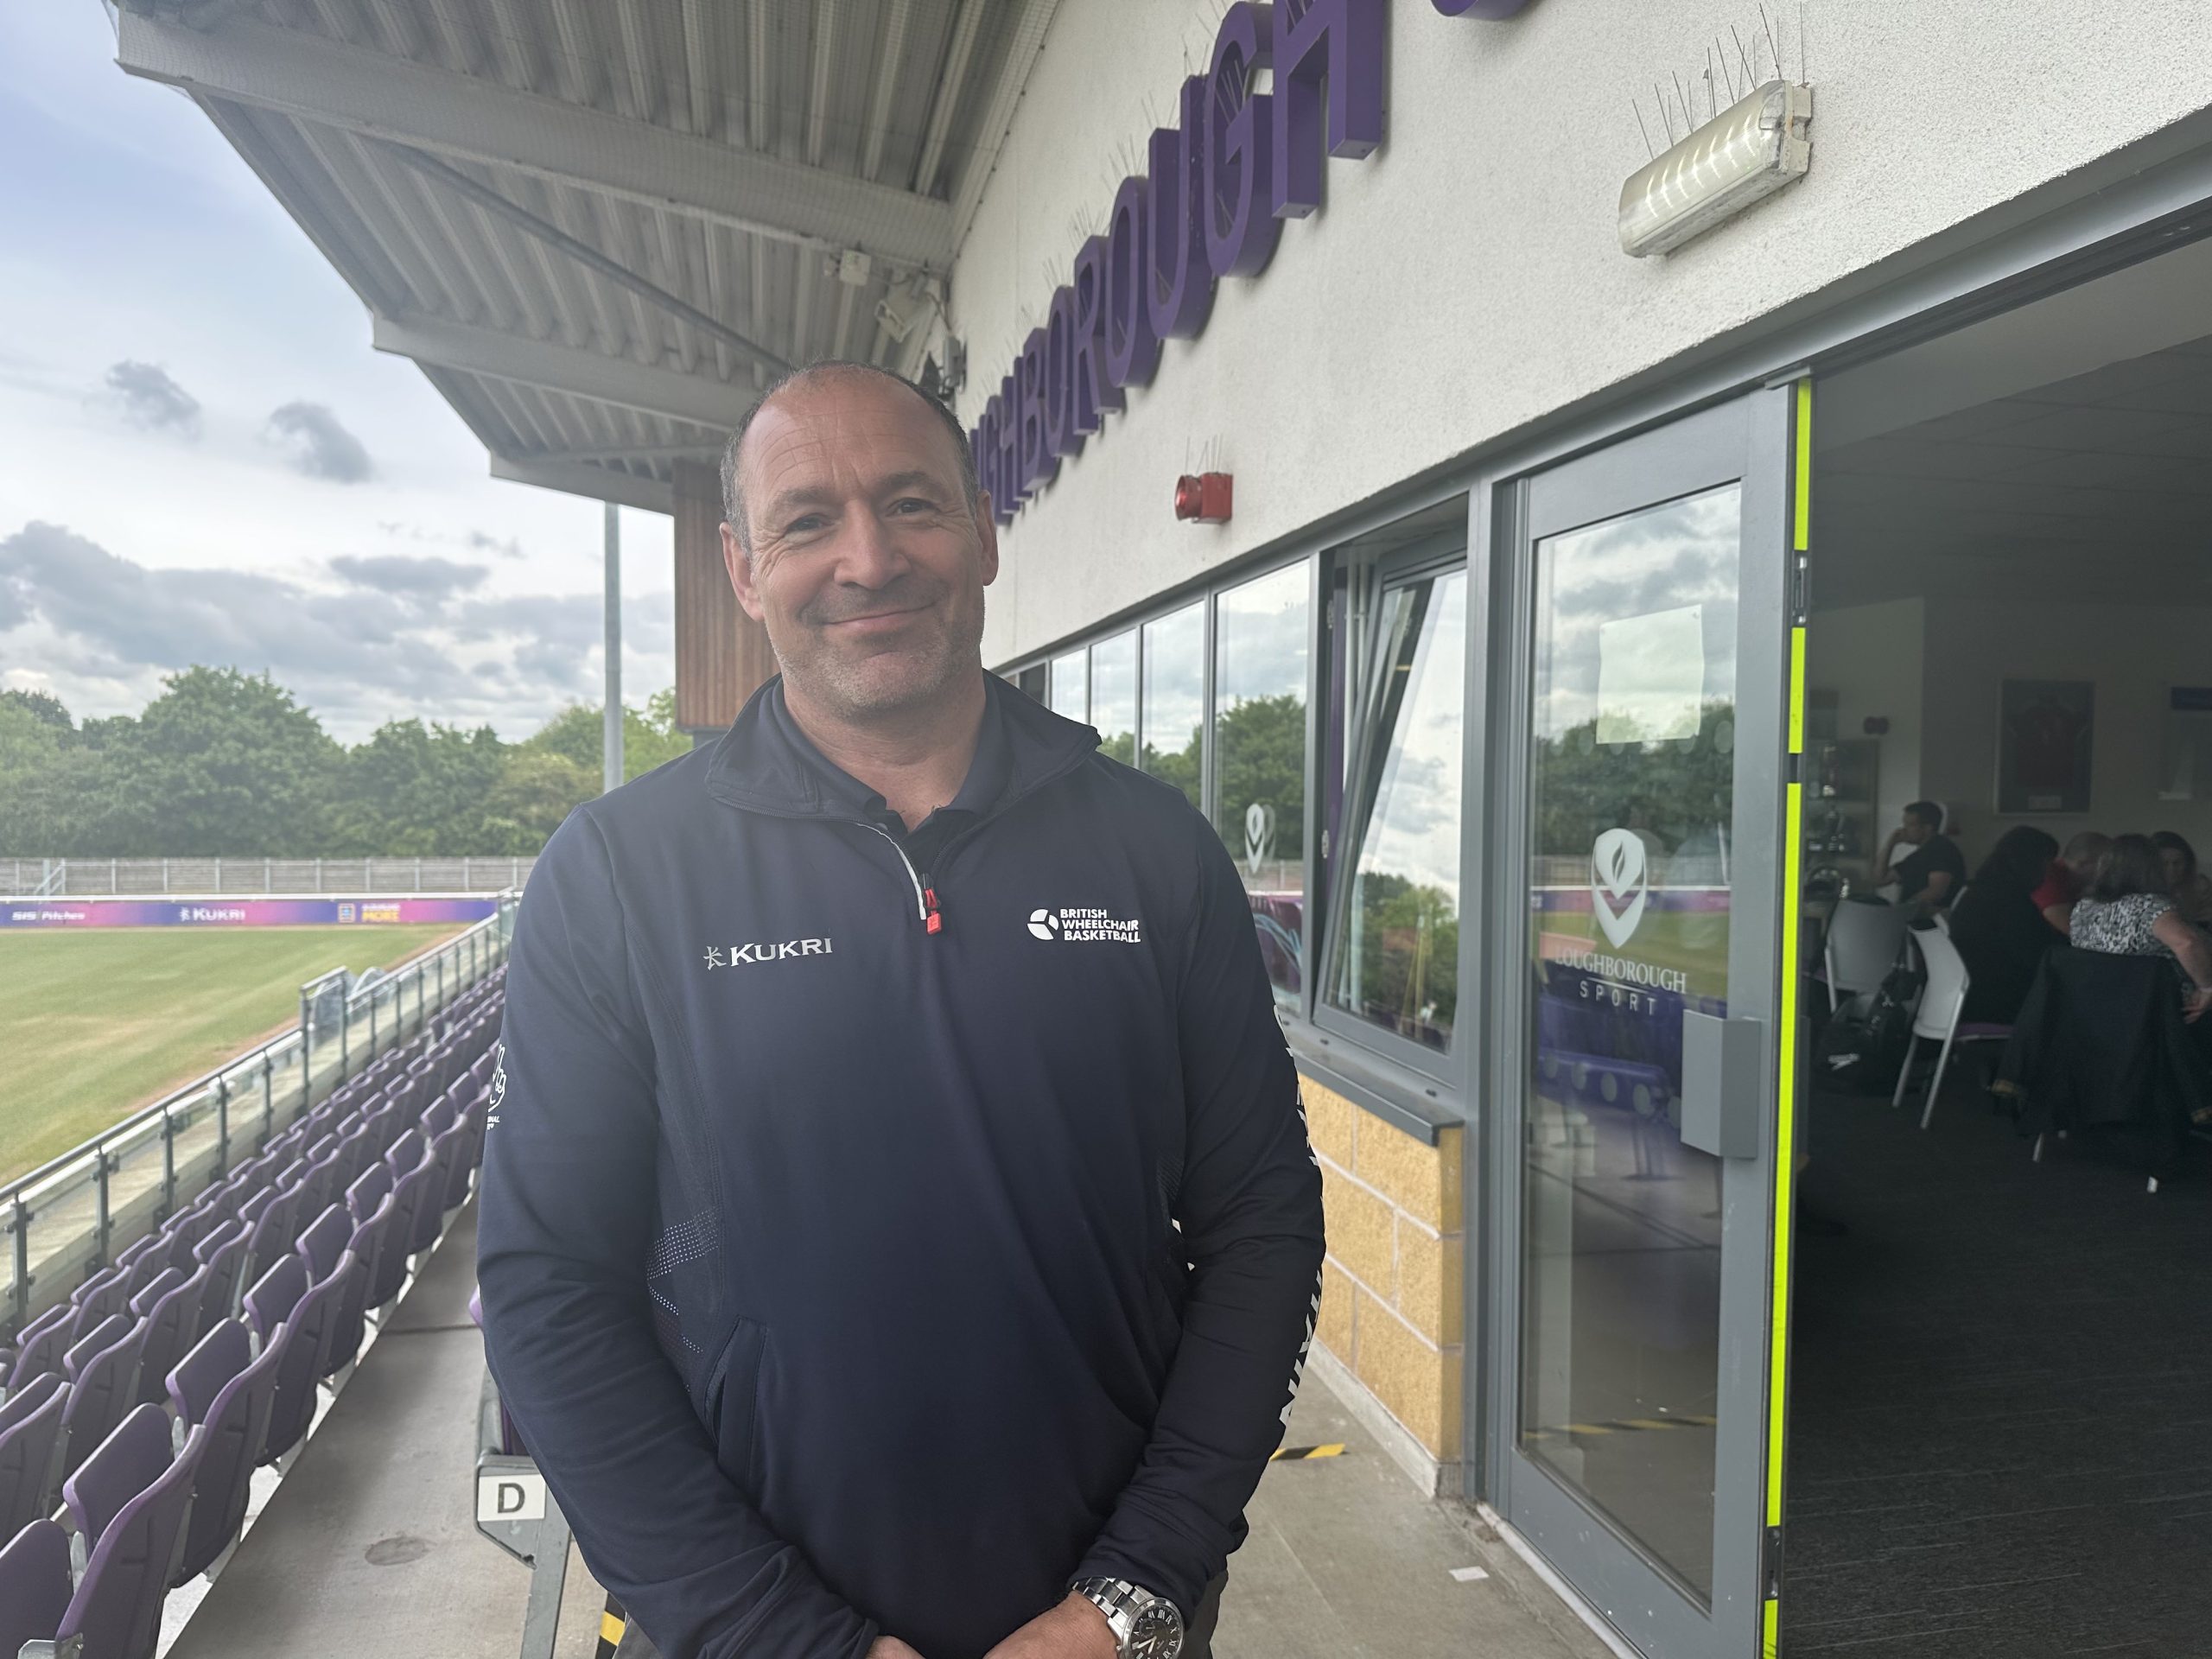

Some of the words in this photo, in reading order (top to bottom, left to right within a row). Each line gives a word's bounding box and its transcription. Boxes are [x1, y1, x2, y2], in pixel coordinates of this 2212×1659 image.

[969, 0, 1384, 526] GHBOROUGH
[193, 907, 245, 921] KUKRI
[1060, 908, 1107, 918] BRITISH
[1062, 919, 1139, 931] WHEELCHAIR
[1064, 930, 1141, 943] BASKETBALL
[730, 938, 833, 967] KUKRI
[1555, 948, 1688, 995] LOUGHBOROUGH
[1580, 981, 1656, 1016] SPORT
[498, 1483, 525, 1514] D
